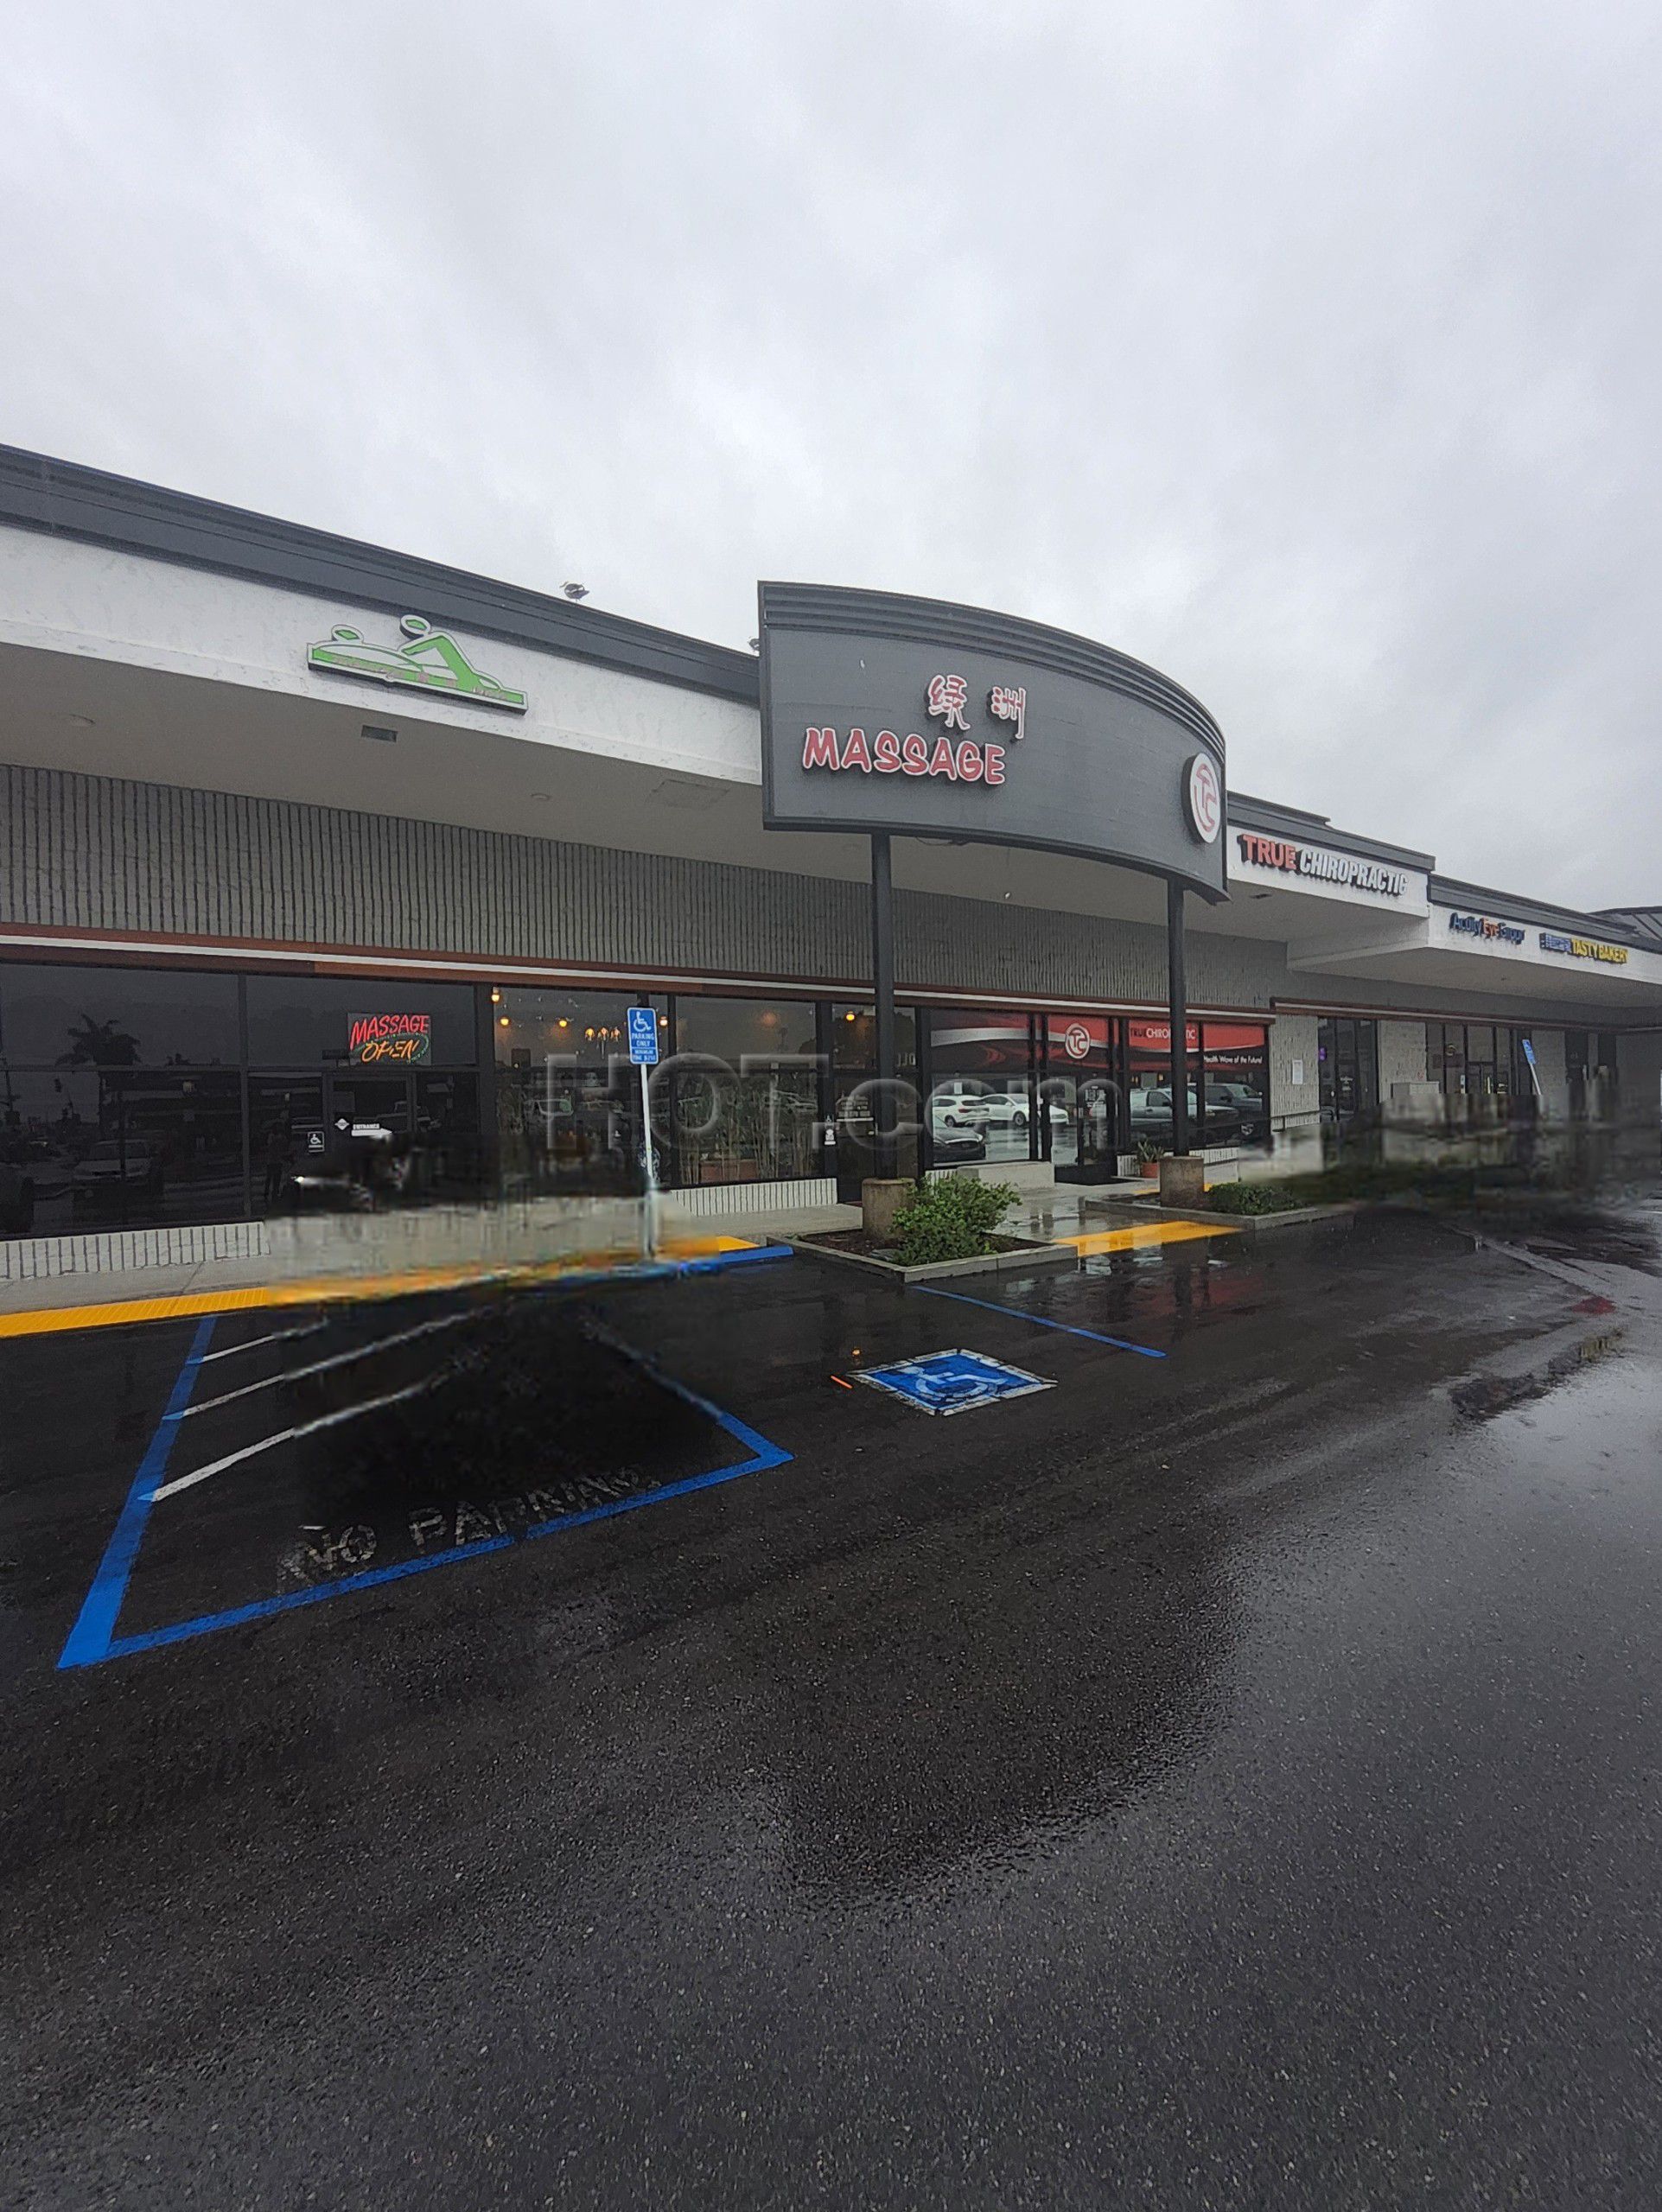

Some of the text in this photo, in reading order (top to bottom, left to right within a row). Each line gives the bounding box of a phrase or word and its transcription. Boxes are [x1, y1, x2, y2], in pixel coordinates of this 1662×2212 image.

[803, 727, 1006, 785] MASSAGE
[1242, 833, 1409, 896] TRUE CHIROPRACTIC
[1482, 918, 1500, 938] Eye
[1570, 938, 1598, 957] TASTY
[350, 1014, 430, 1051] MASSAGE
[361, 1039, 420, 1063] OPEN
